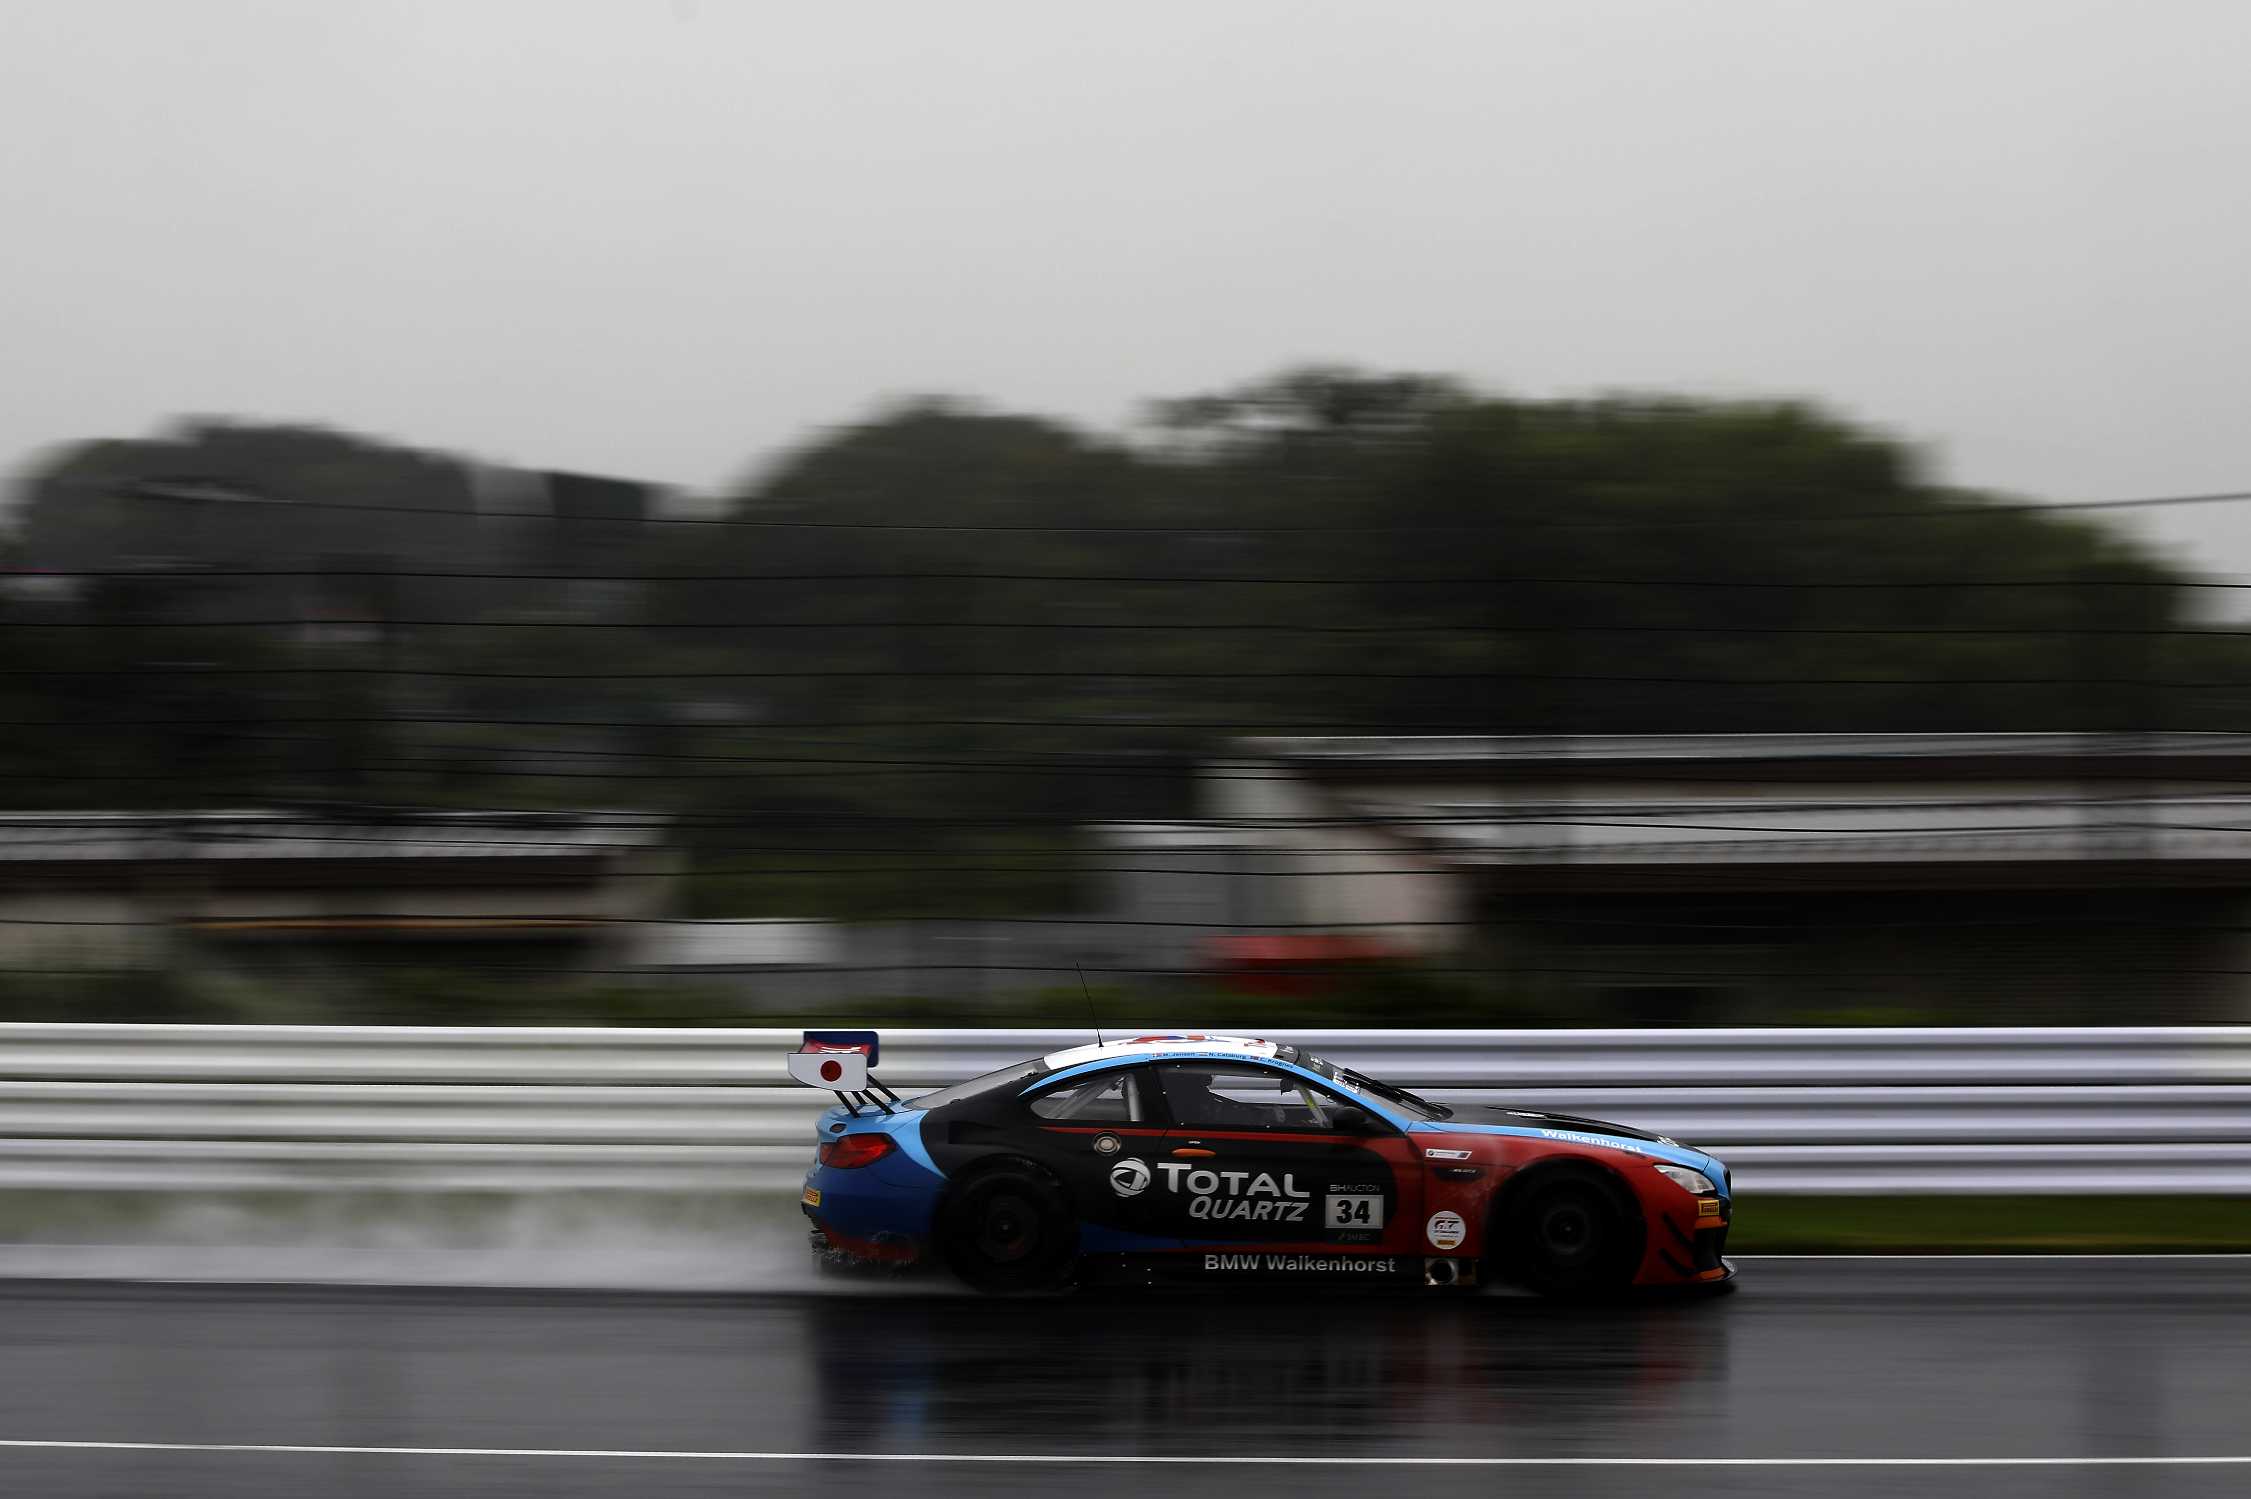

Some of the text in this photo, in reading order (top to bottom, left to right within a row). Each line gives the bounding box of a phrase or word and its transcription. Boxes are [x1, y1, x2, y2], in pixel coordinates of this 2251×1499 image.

[1540, 1128, 1643, 1153] Walkenhorst
[1157, 1162, 1311, 1198] TOTAL
[1188, 1195, 1310, 1222] QUARTZ
[1335, 1199, 1371, 1224] 34
[1204, 1254, 1396, 1272] BMW Walkenhorst
